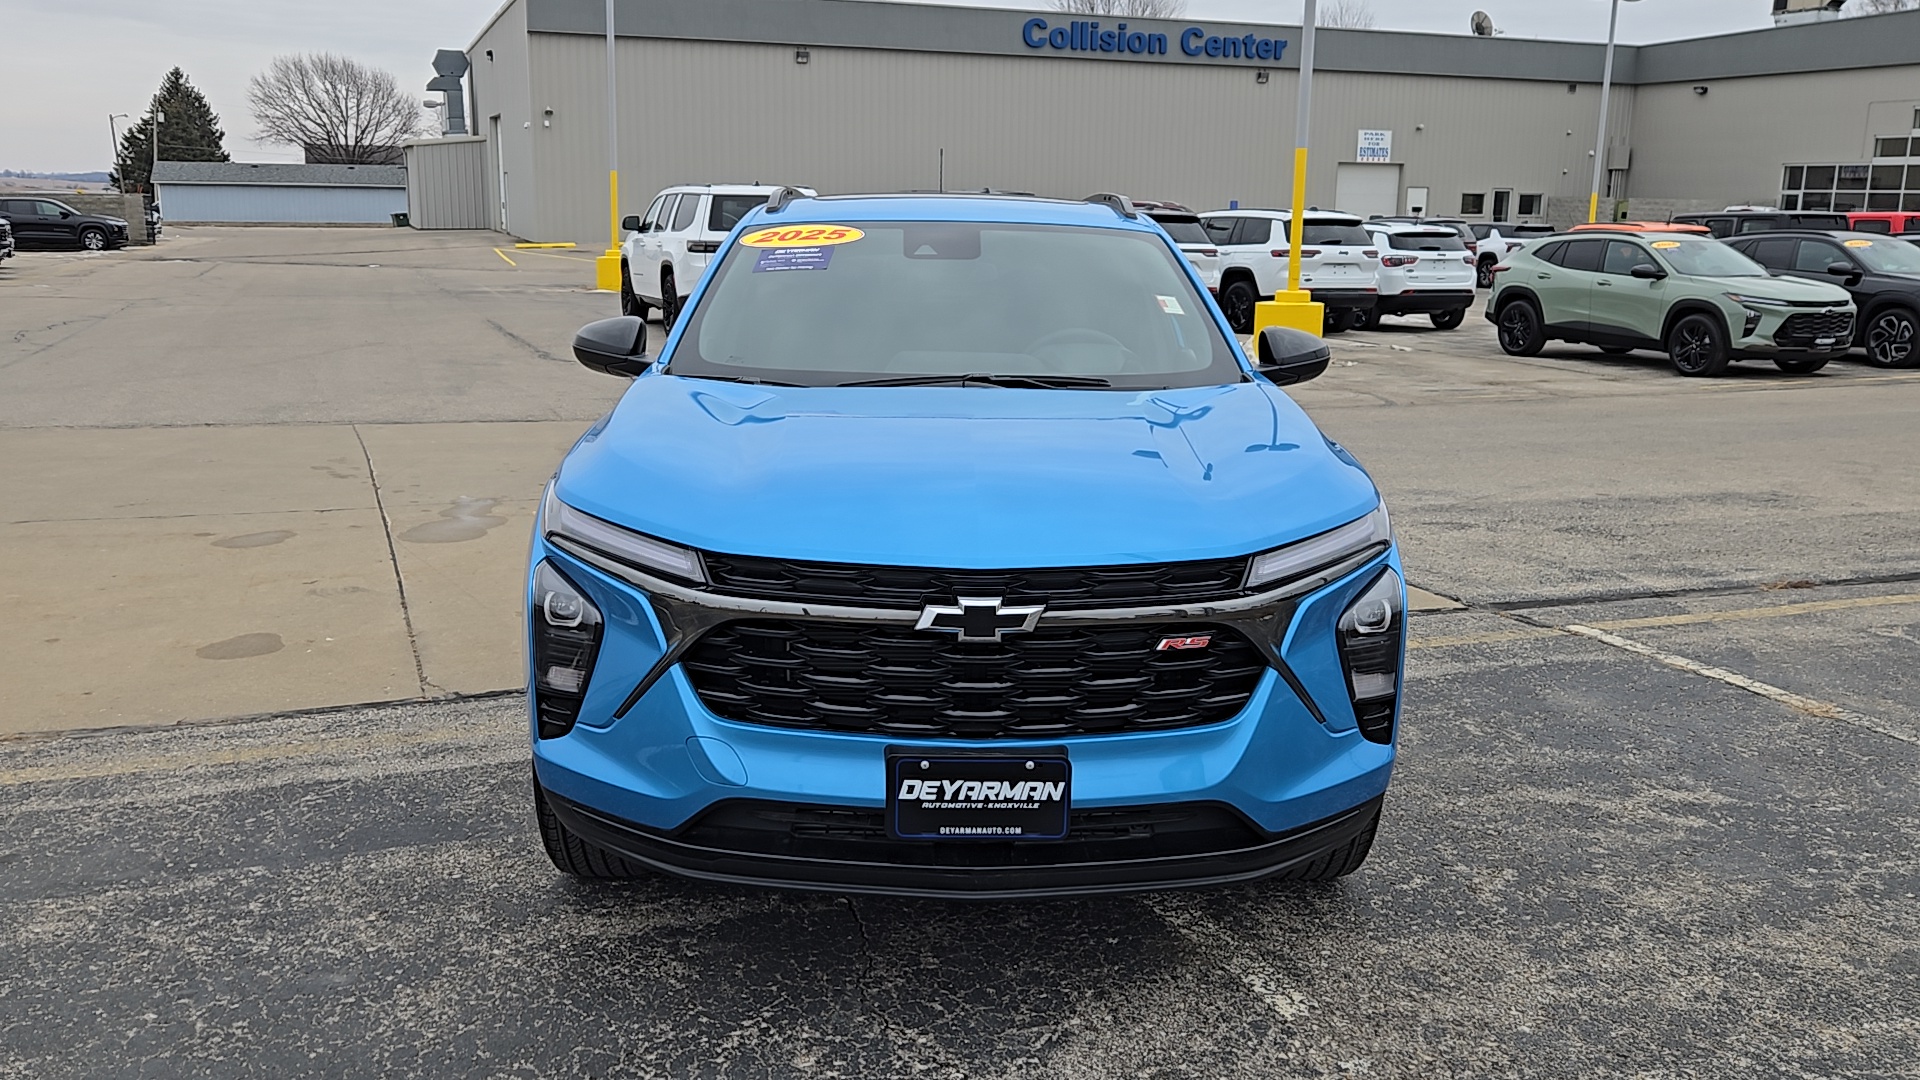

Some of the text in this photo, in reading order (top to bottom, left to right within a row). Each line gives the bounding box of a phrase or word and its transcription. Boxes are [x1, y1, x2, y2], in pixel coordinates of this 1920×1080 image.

[1022, 18, 1287, 60] Collision Center
[1359, 147, 1388, 157] ESTIMATES
[752, 229, 851, 243] 2025
[1156, 636, 1212, 650] RS
[898, 779, 1066, 801] DEYARMAN
[939, 826, 1022, 835] DEYARMANAUTO.COM
